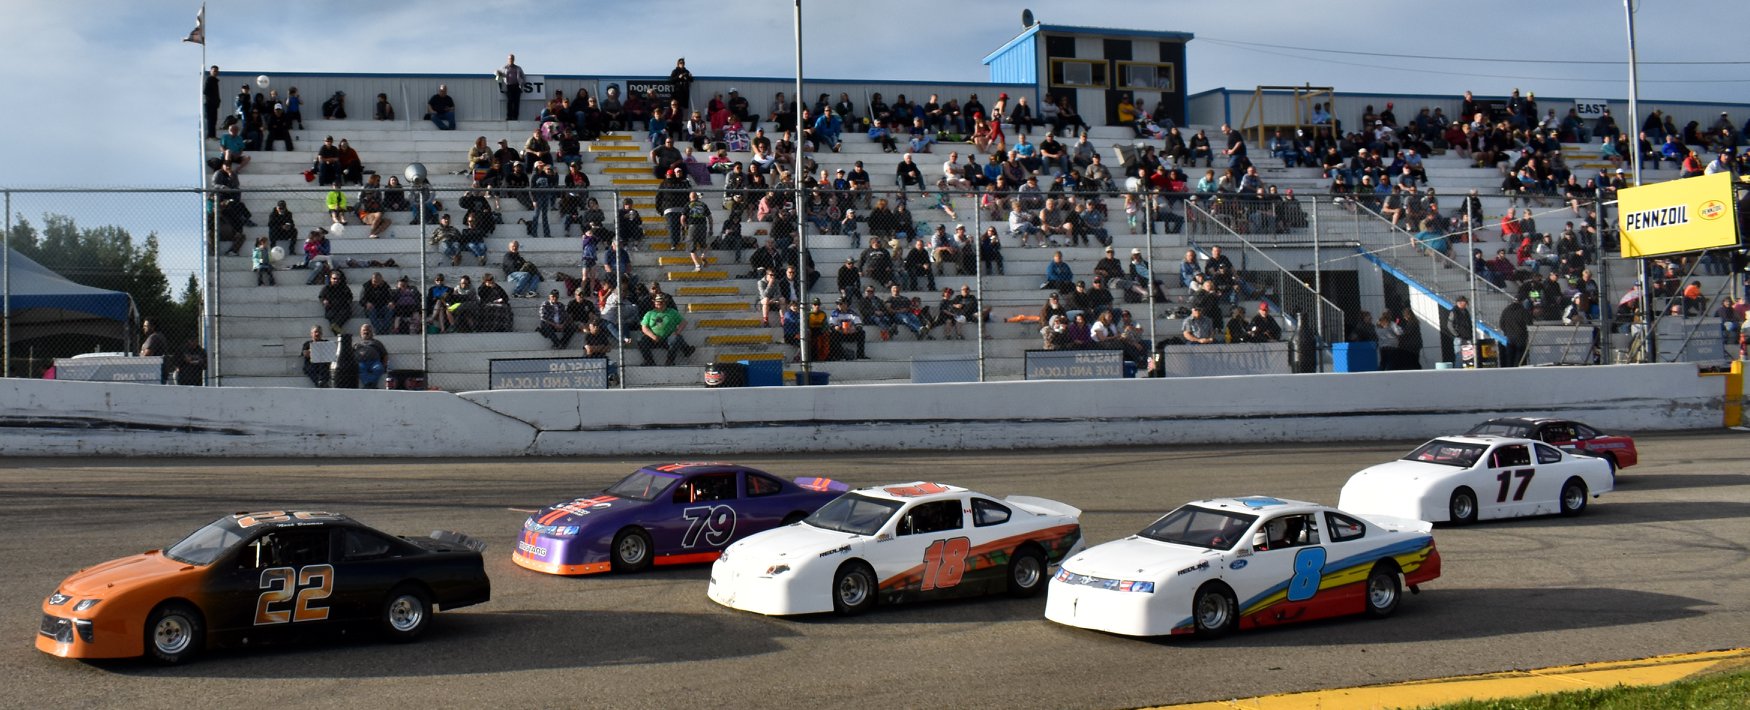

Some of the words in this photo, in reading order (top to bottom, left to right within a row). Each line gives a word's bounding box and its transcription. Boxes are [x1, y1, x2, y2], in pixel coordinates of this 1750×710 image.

[499, 82, 544, 94] ST
[629, 84, 650, 92] DON
[652, 84, 676, 92] FORT
[1577, 103, 1607, 114] EAST
[1626, 206, 1688, 231] PENNZOIL
[1496, 468, 1535, 503] 17
[682, 504, 736, 548] 79
[920, 536, 971, 591] 18
[1287, 546, 1327, 602] 8
[254, 563, 335, 626] 22
